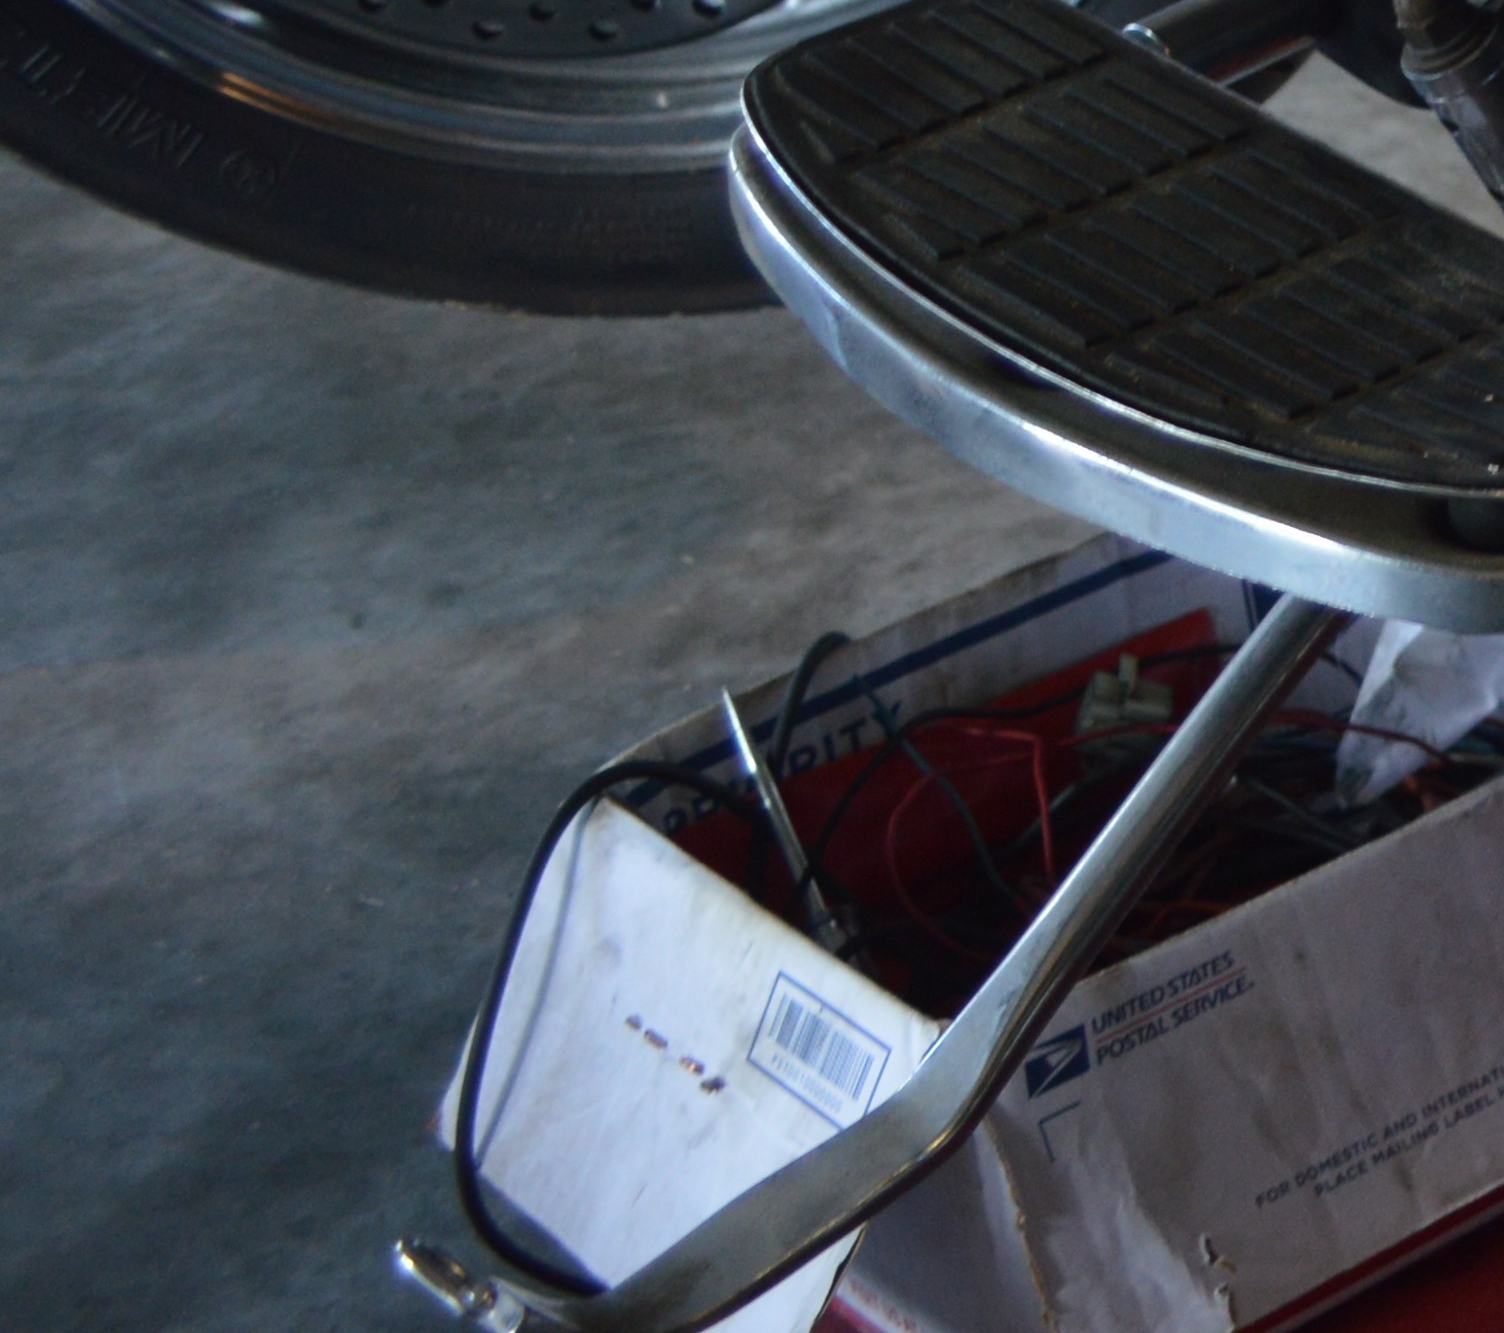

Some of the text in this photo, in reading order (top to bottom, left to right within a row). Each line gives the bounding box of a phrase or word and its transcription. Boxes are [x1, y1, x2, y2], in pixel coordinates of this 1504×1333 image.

[662, 700, 905, 833] PRRITY
[1089, 950, 1236, 1035] UNITED STATES
[1093, 1016, 1169, 1065] POSTAL
[1253, 1179, 1293, 1209] FOR
[1292, 1131, 1379, 1189] DOMESTIC
[1379, 1110, 1419, 1141] AND
[1310, 1158, 1370, 1199] PLACE
[1368, 1120, 1441, 1167] MAILING
[1440, 1090, 1496, 1129] LABEL
